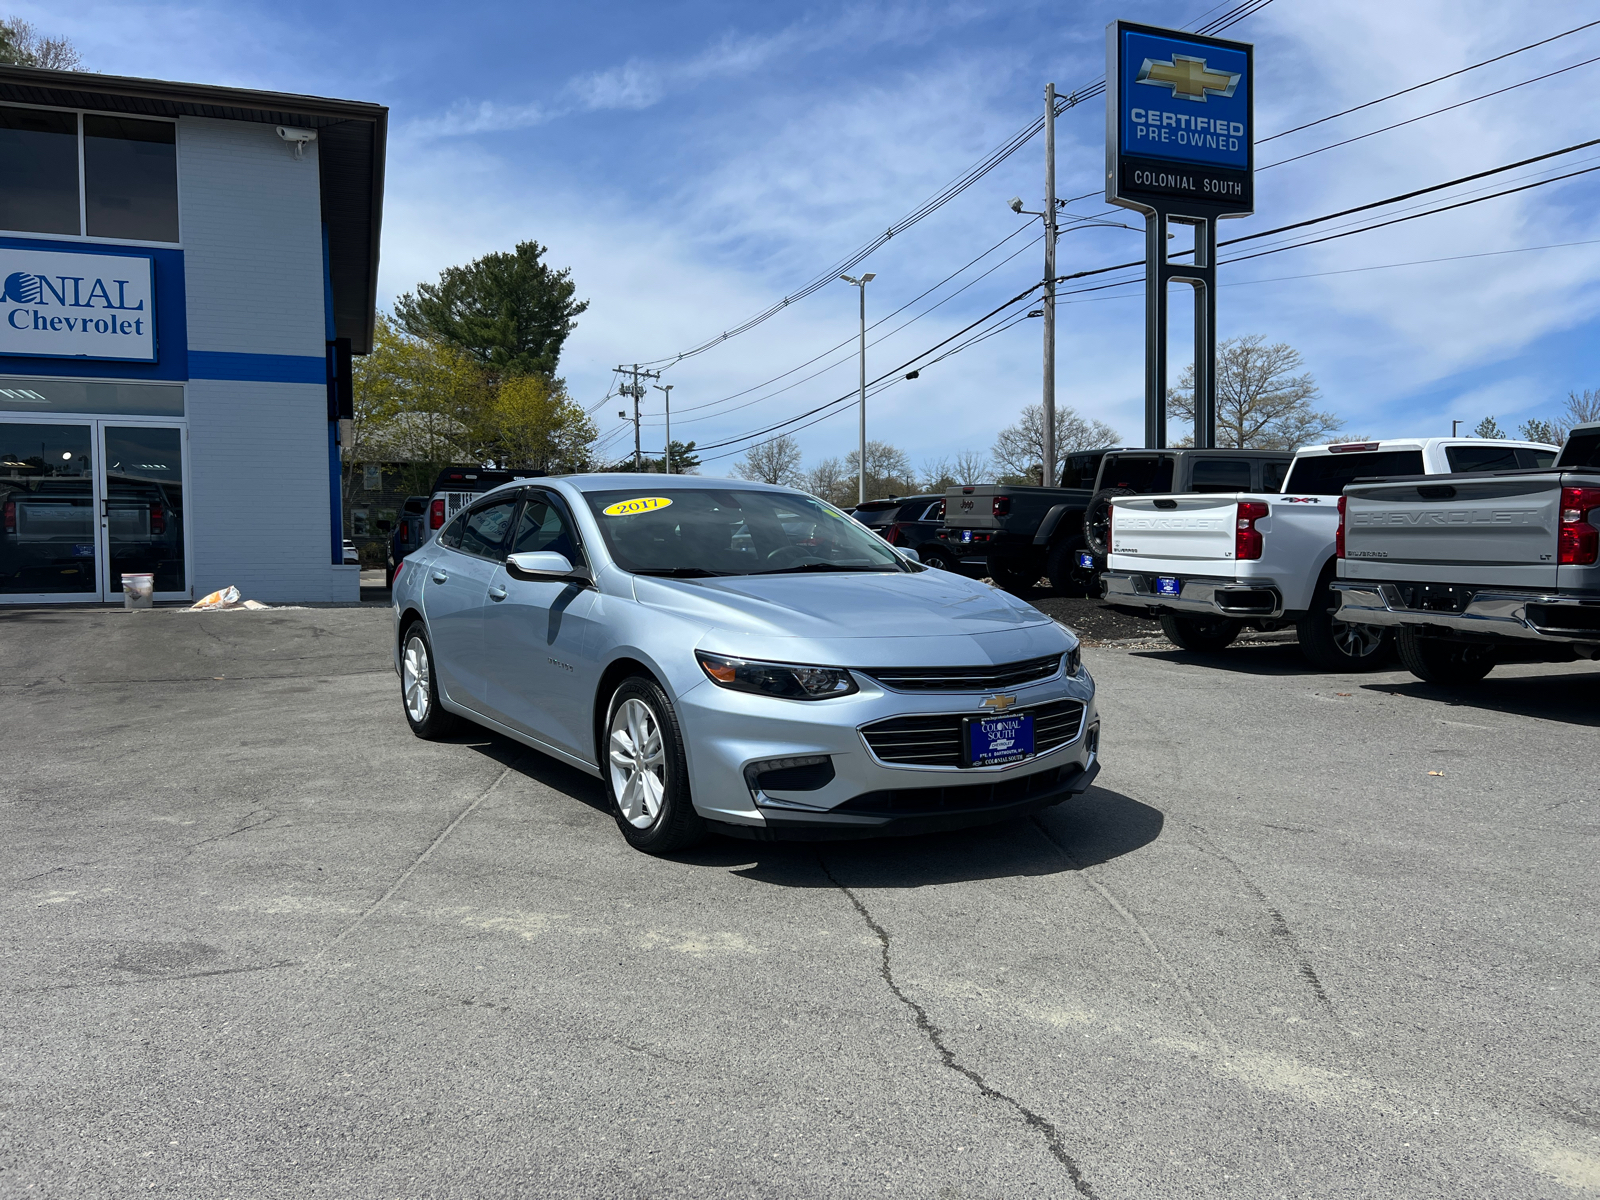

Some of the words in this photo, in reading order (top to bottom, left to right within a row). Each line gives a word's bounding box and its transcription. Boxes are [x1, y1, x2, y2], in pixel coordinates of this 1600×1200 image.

[1131, 108, 1244, 137] CERTIFIED
[1137, 126, 1239, 152] PRE-OWNED
[1134, 170, 1196, 190] COLONIAL
[1203, 178, 1242, 196] SOUTH
[0, 271, 144, 311] ONIAL
[8, 308, 144, 336] Chevrolet
[616, 498, 658, 515] 2017
[960, 499, 974, 511] Jeep
[1116, 518, 1223, 530] CHEVROLET
[1353, 509, 1538, 526] CHEVROLET
[1347, 549, 1388, 558] SILVERADO
[1539, 553, 1552, 561] LT
[982, 721, 1021, 732] COLONIAL
[988, 730, 1015, 740] SOUTH
